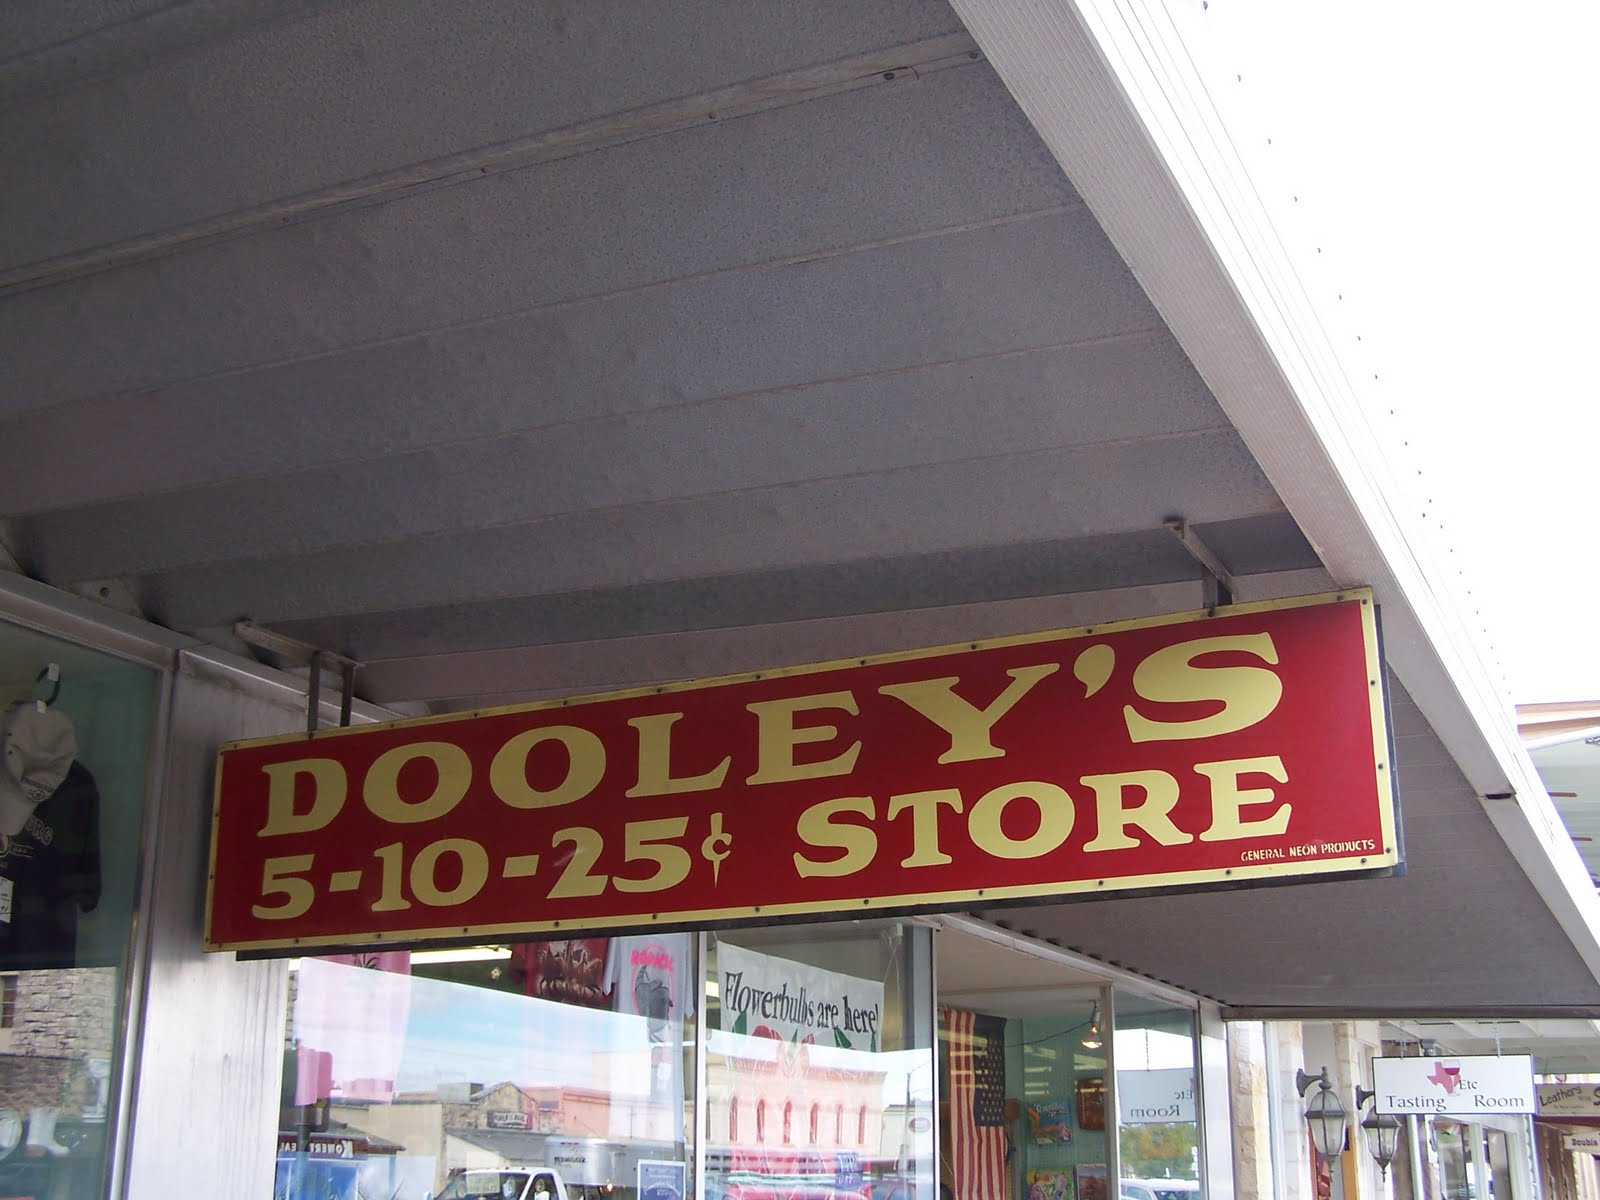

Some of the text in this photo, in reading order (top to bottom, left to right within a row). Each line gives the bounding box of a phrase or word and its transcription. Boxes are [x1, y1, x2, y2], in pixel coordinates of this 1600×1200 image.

[256, 632, 1283, 837] DOOLEY'S
[251, 755, 1292, 920] 5-10-25¢ STORE
[1240, 839, 1376, 862] GENERAL NEON PRODUCTS
[725, 971, 879, 1035] Flowerbulbs are here!
[1458, 1079, 1478, 1091] Etc
[1539, 1086, 1582, 1107] Leathers
[1385, 1093, 1525, 1112] Tasting Room
